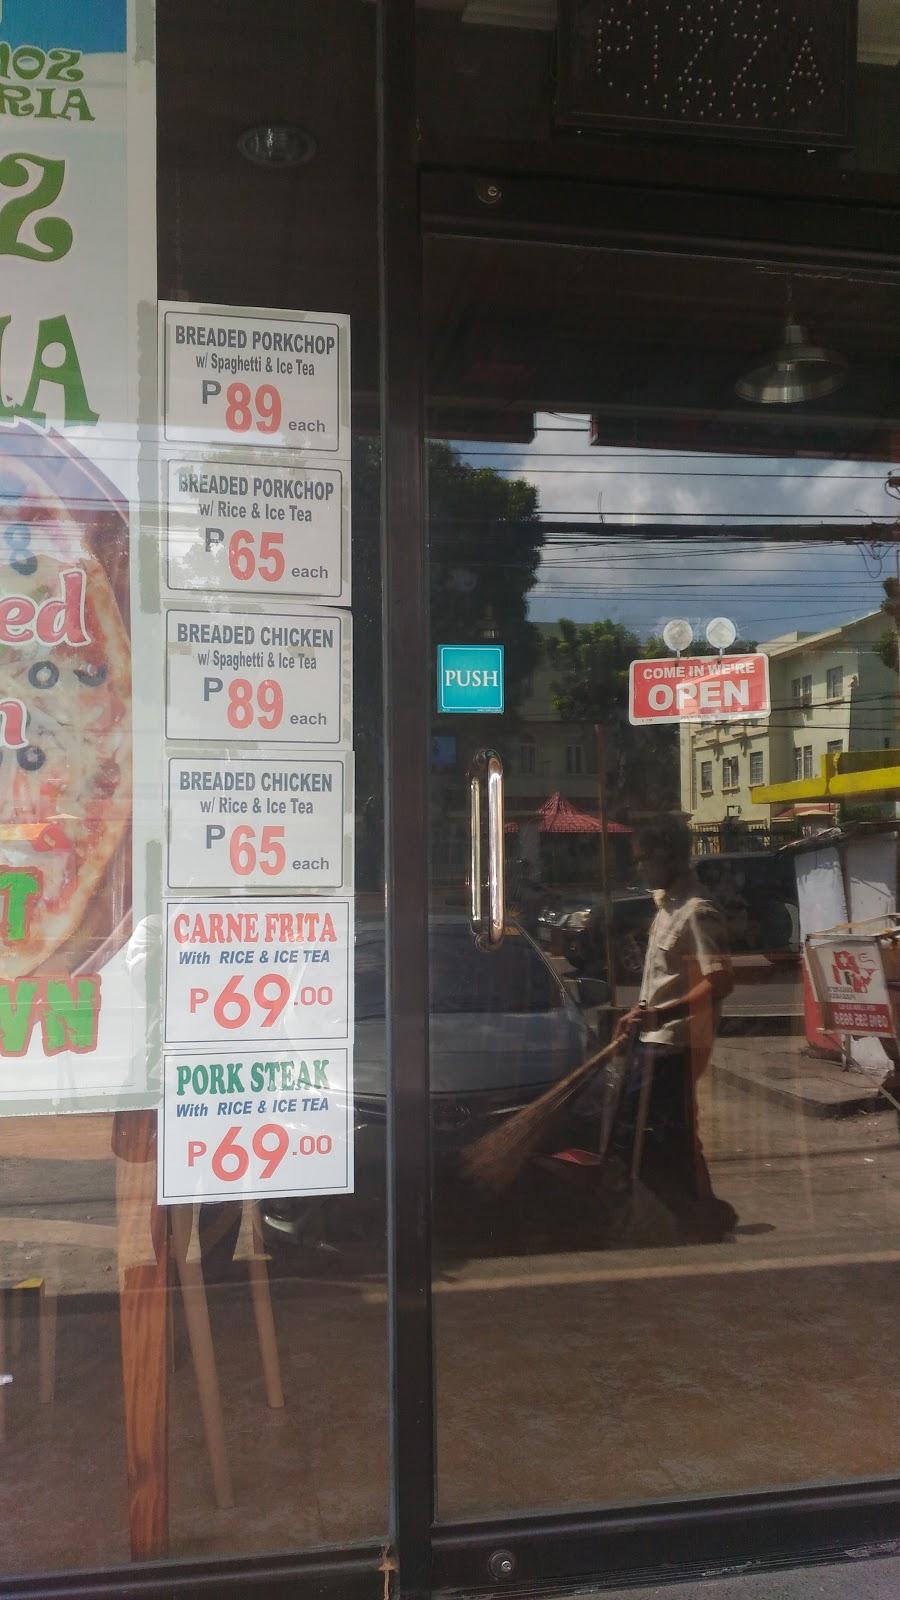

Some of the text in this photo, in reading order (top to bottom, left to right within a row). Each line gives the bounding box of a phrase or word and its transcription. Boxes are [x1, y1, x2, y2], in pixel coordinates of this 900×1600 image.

[598, 19, 824, 94] PIZZA
[176, 325, 335, 354] BREADED PORKCHOP
[196, 353, 314, 376] w/ Spaghetti & Ice Tea
[289, 420, 325, 432] each
[179, 474, 333, 500] BREADED PORKCHOP
[200, 501, 312, 521] w/ Rice & Ice Tea
[292, 566, 328, 578] each
[178, 623, 333, 648] BREADED CHICKEN
[198, 650, 316, 671] w/ Spaghetti & Ice Tea
[643, 662, 755, 679] COME IN WE'RE
[445, 670, 498, 686] PUSH
[648, 680, 749, 711] OPEN
[290, 713, 326, 725] each
[180, 771, 332, 792] BREADED CHICKEN
[200, 797, 313, 813] w/ Rice & Ice Tea
[292, 857, 329, 869] each
[174, 912, 337, 943] CARNE FRITA
[179, 950, 330, 964] With RICE & ICE TEA
[177, 1060, 329, 1095] PORK STEAK
[177, 1098, 328, 1117] With RICE & ICE TEA
